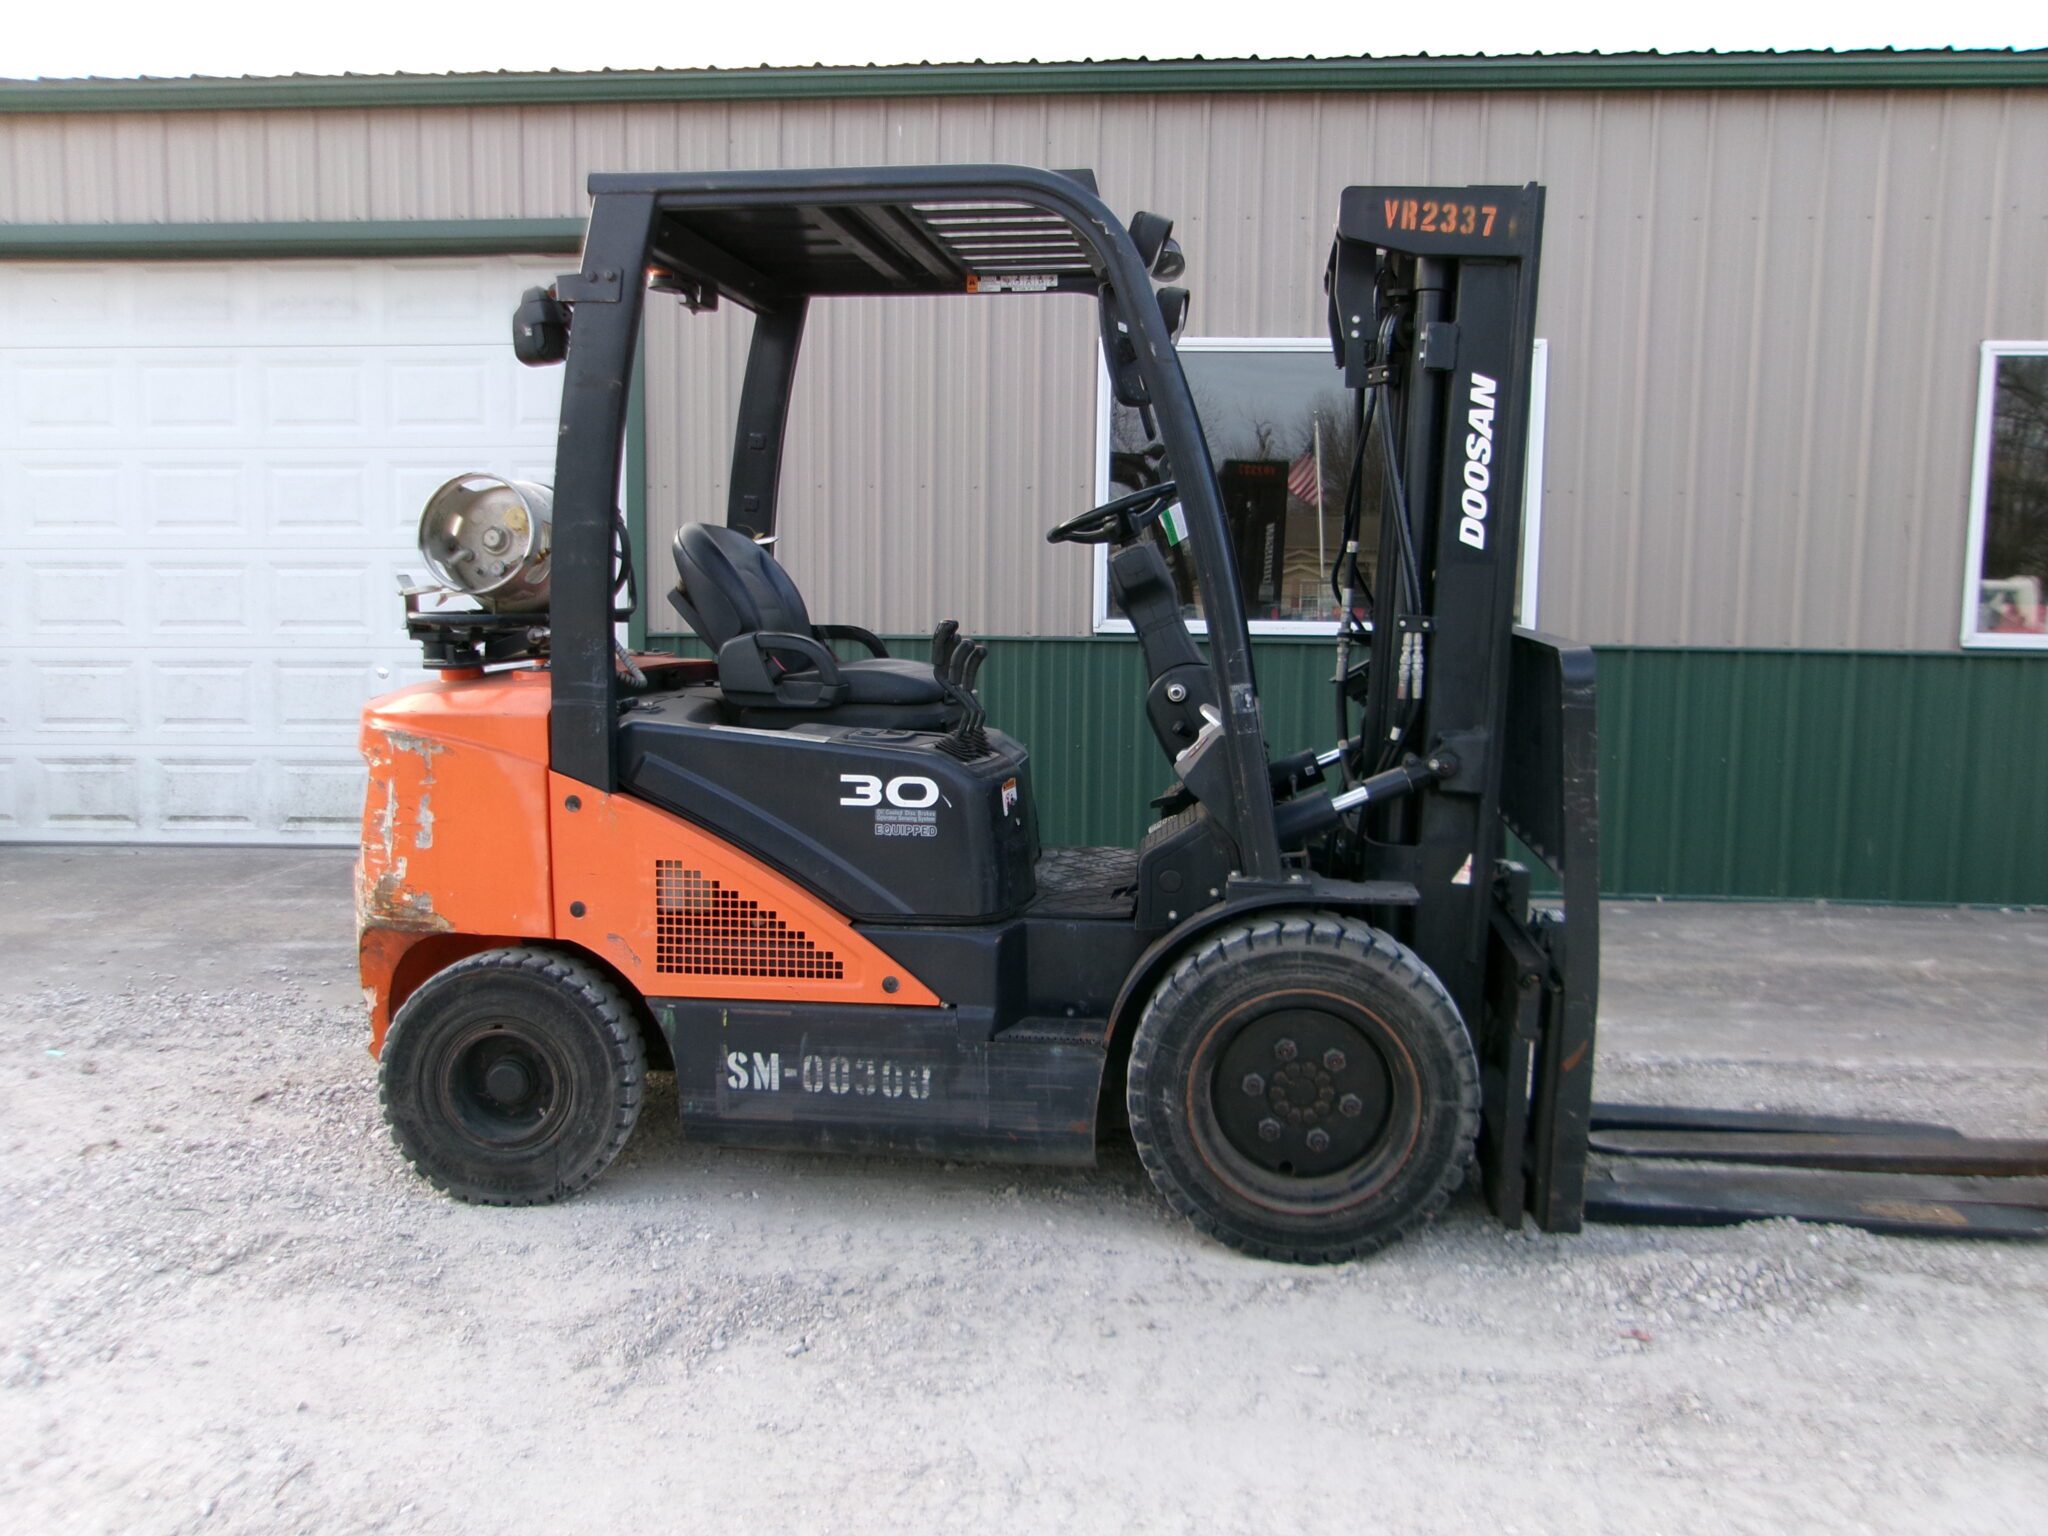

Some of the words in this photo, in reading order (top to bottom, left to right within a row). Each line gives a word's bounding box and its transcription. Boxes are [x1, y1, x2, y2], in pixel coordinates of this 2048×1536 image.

[1384, 199, 1497, 237] VR2337
[1459, 372, 1496, 550] DOOSAN
[840, 774, 939, 808] 30
[875, 823, 938, 837] EQUIPPED
